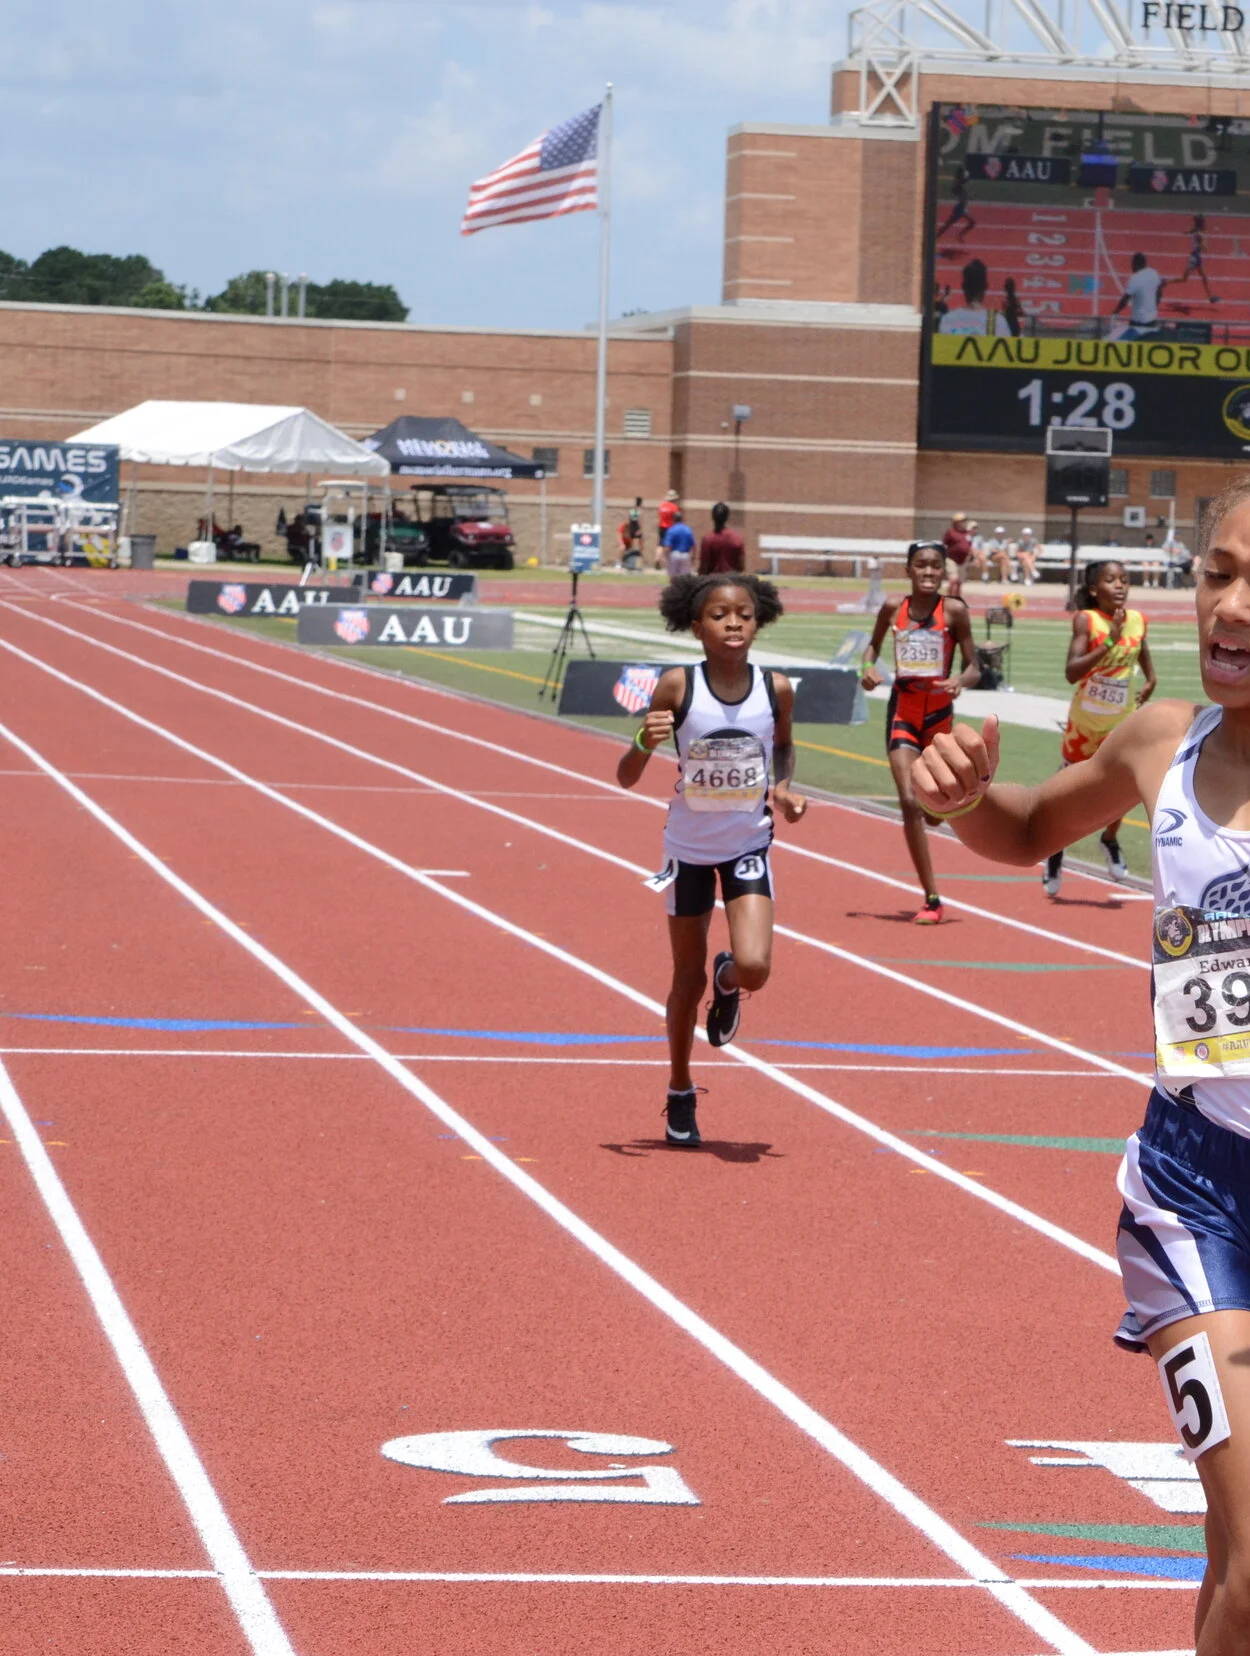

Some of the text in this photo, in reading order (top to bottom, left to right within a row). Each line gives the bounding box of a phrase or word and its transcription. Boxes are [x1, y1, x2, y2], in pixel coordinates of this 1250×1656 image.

[1141, 2, 1245, 32] FIELD
[1006, 160, 1052, 180] AAU
[1172, 173, 1217, 192] AAU
[955, 336, 1039, 364] AAU
[1053, 341, 1202, 370] JUNIOR
[1017, 379, 1135, 430] 1:28
[395, 575, 453, 597] AAU
[378, 614, 473, 644] AAU
[691, 767, 757, 788] 4668
[1164, 1345, 1213, 1449] 5
